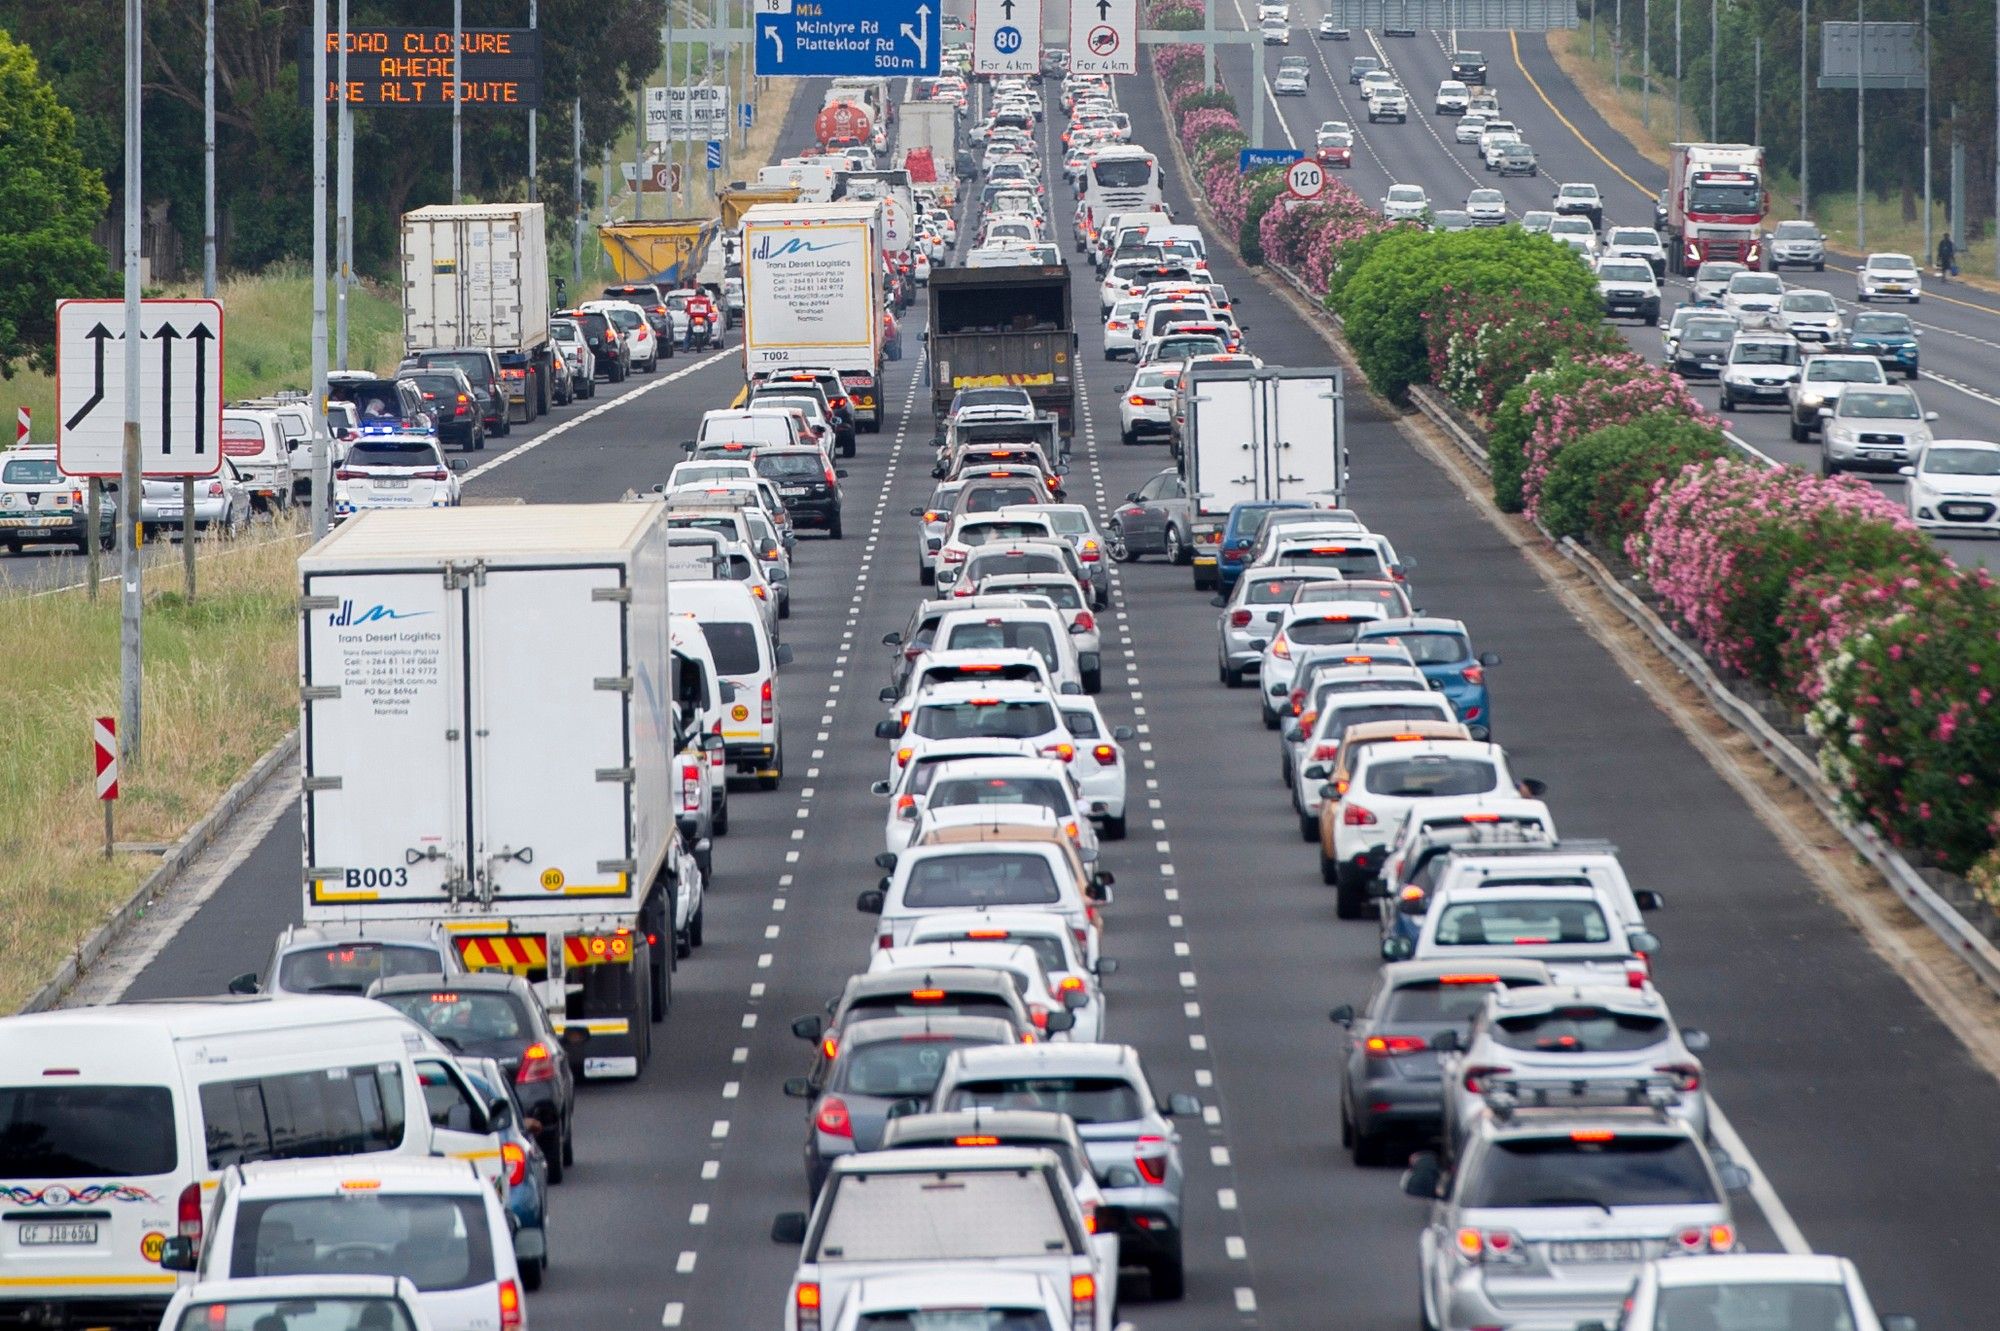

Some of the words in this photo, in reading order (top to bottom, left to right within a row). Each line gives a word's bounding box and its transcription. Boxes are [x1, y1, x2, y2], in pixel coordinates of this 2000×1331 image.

[796, 4, 823, 17] M14
[796, 20, 855, 37] McIntyre
[860, 20, 879, 34] Rd
[326, 32, 388, 53] ROAD
[796, 38, 870, 51] Plattekloof
[876, 38, 894, 51] Rd
[996, 32, 1018, 48] 80
[980, 60, 999, 71] For
[1076, 60, 1096, 71] For
[380, 81, 427, 102] ALT
[654, 90, 663, 101] IF
[649, 109, 683, 121] YOURE
[1294, 170, 1320, 187] 120
[788, 260, 815, 268] Desert
[816, 259, 851, 268] Logistics
[762, 352, 789, 361] T002
[328, 600, 354, 627] tdl
[338, 634, 363, 644] Trans
[366, 633, 397, 643] Desert
[399, 631, 442, 643] Logistics
[345, 867, 408, 887] B003
